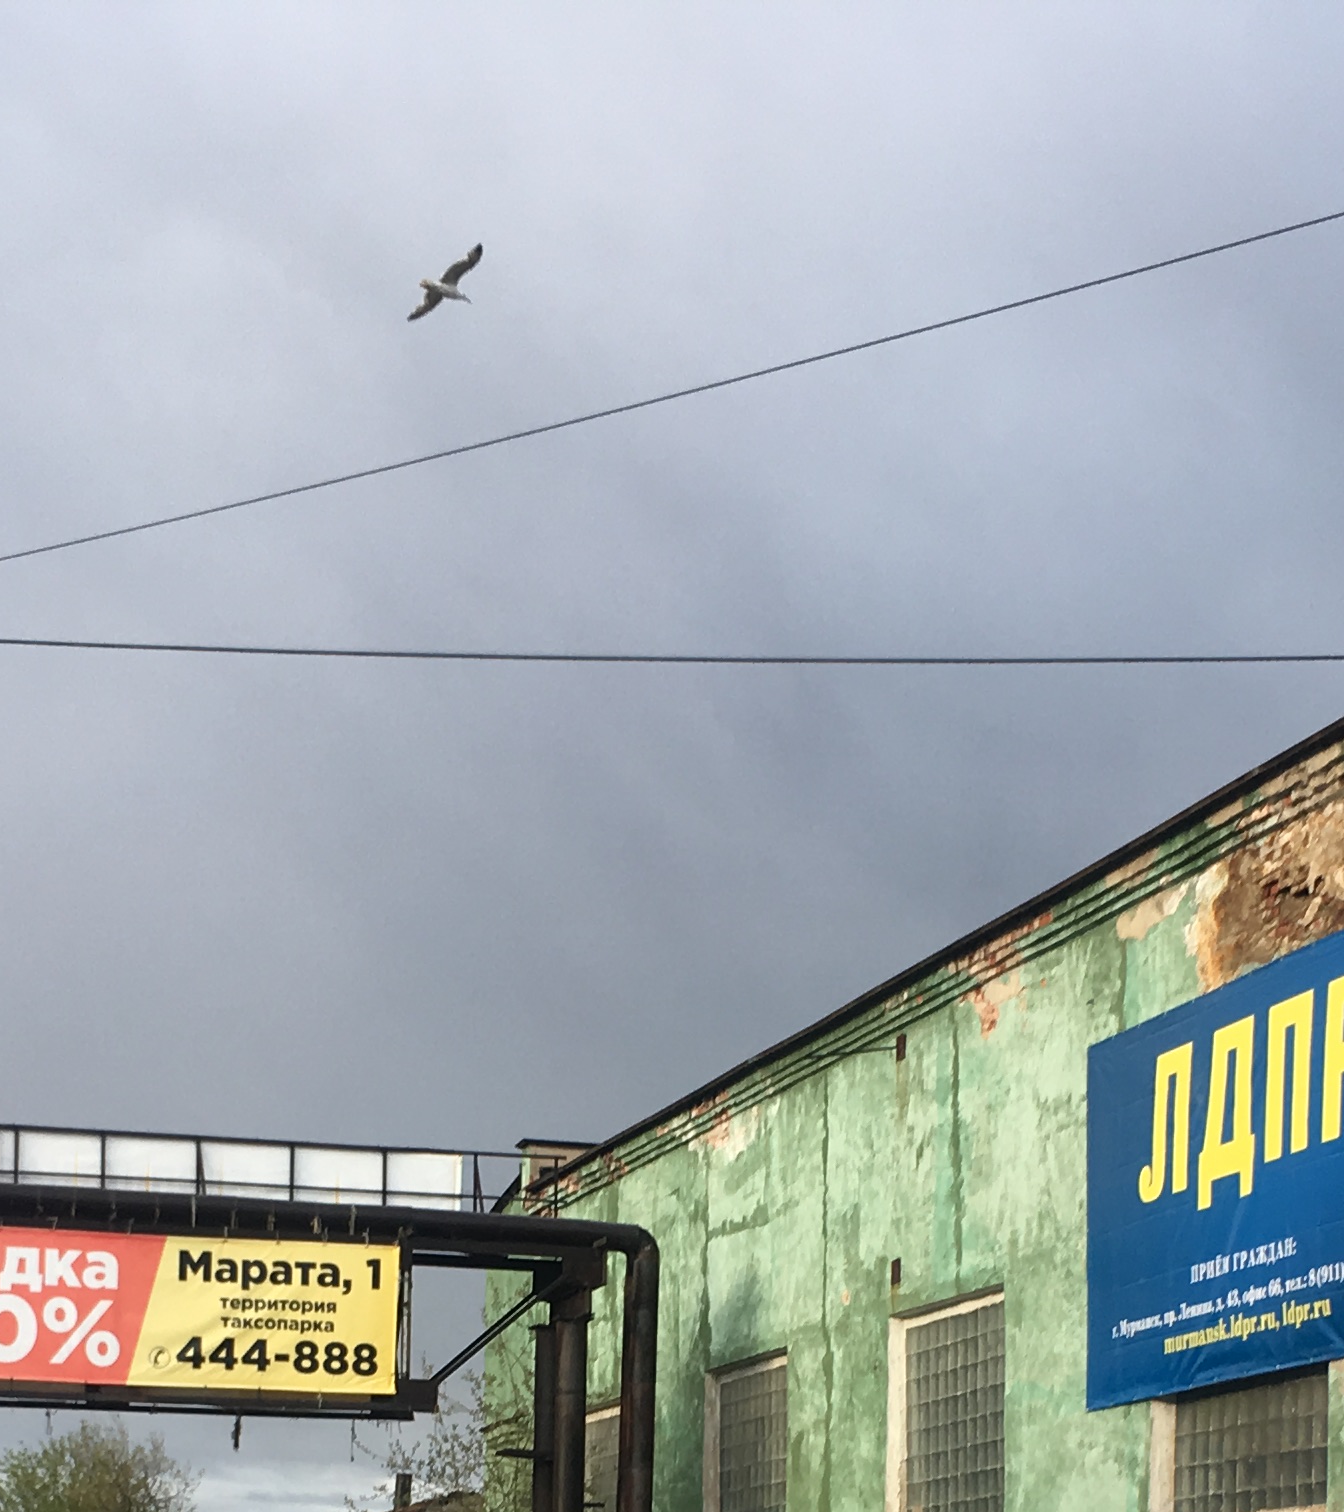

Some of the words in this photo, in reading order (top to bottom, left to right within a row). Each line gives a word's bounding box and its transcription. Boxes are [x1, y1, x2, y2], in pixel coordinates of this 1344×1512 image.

[178, 1250, 353, 1295] Марата,
[366, 1258, 381, 1290] 1
[1232, 1237, 1297, 1272] ГРАЖДАН:
[219, 1296, 337, 1314] территория
[220, 1315, 335, 1334] таксопарка
[1164, 1310, 1280, 1355] murmansk.ldpr.ru,
[1282, 1298, 1332, 1329] ldpr.ru
[176, 1336, 378, 1376] 444-888
